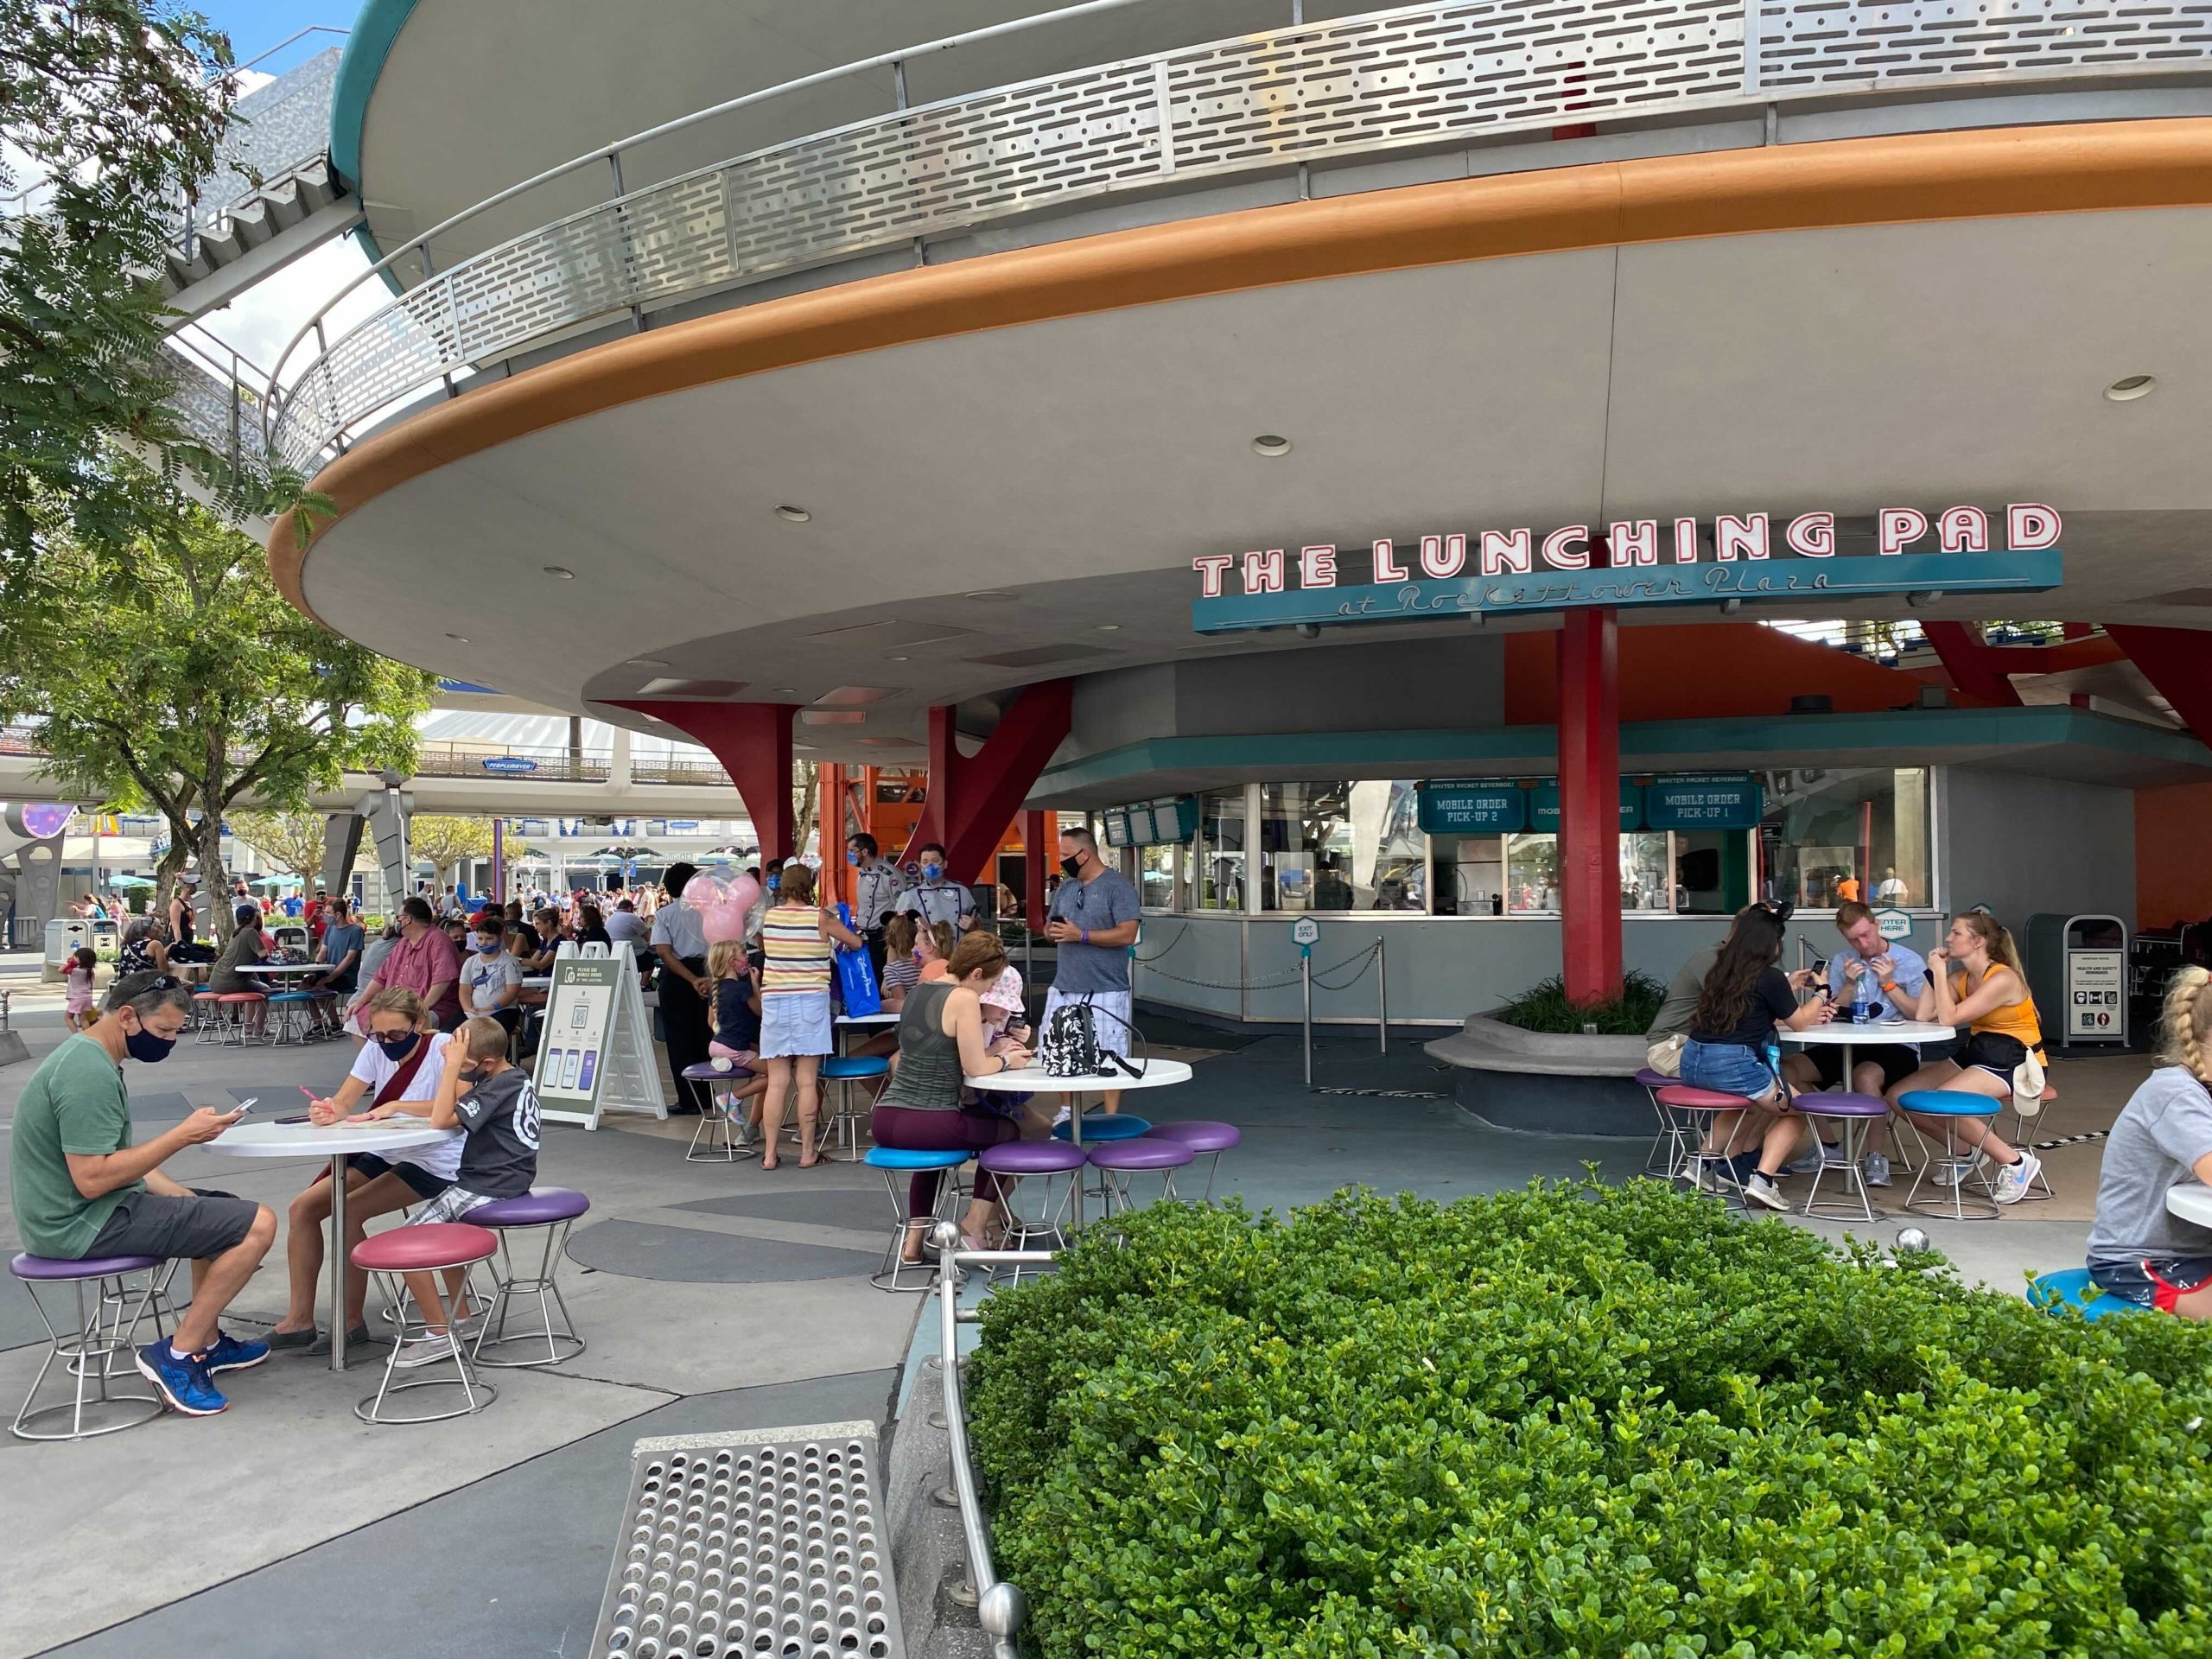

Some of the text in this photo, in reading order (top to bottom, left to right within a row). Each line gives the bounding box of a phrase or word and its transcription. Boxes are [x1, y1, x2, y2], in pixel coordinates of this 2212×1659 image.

[1192, 503, 2063, 598] THE LUNCHING PAD
[1338, 596, 1377, 617] at
[1704, 566, 1830, 592] Plaza
[1437, 798, 1508, 810] MOBILE ORDER
[1665, 793, 1741, 805] MOBILE ORDER
[1447, 811, 1498, 822] PICK-UP 2
[1677, 807, 1729, 818] PICK-UP 1
[156, 835, 172, 849] COO
